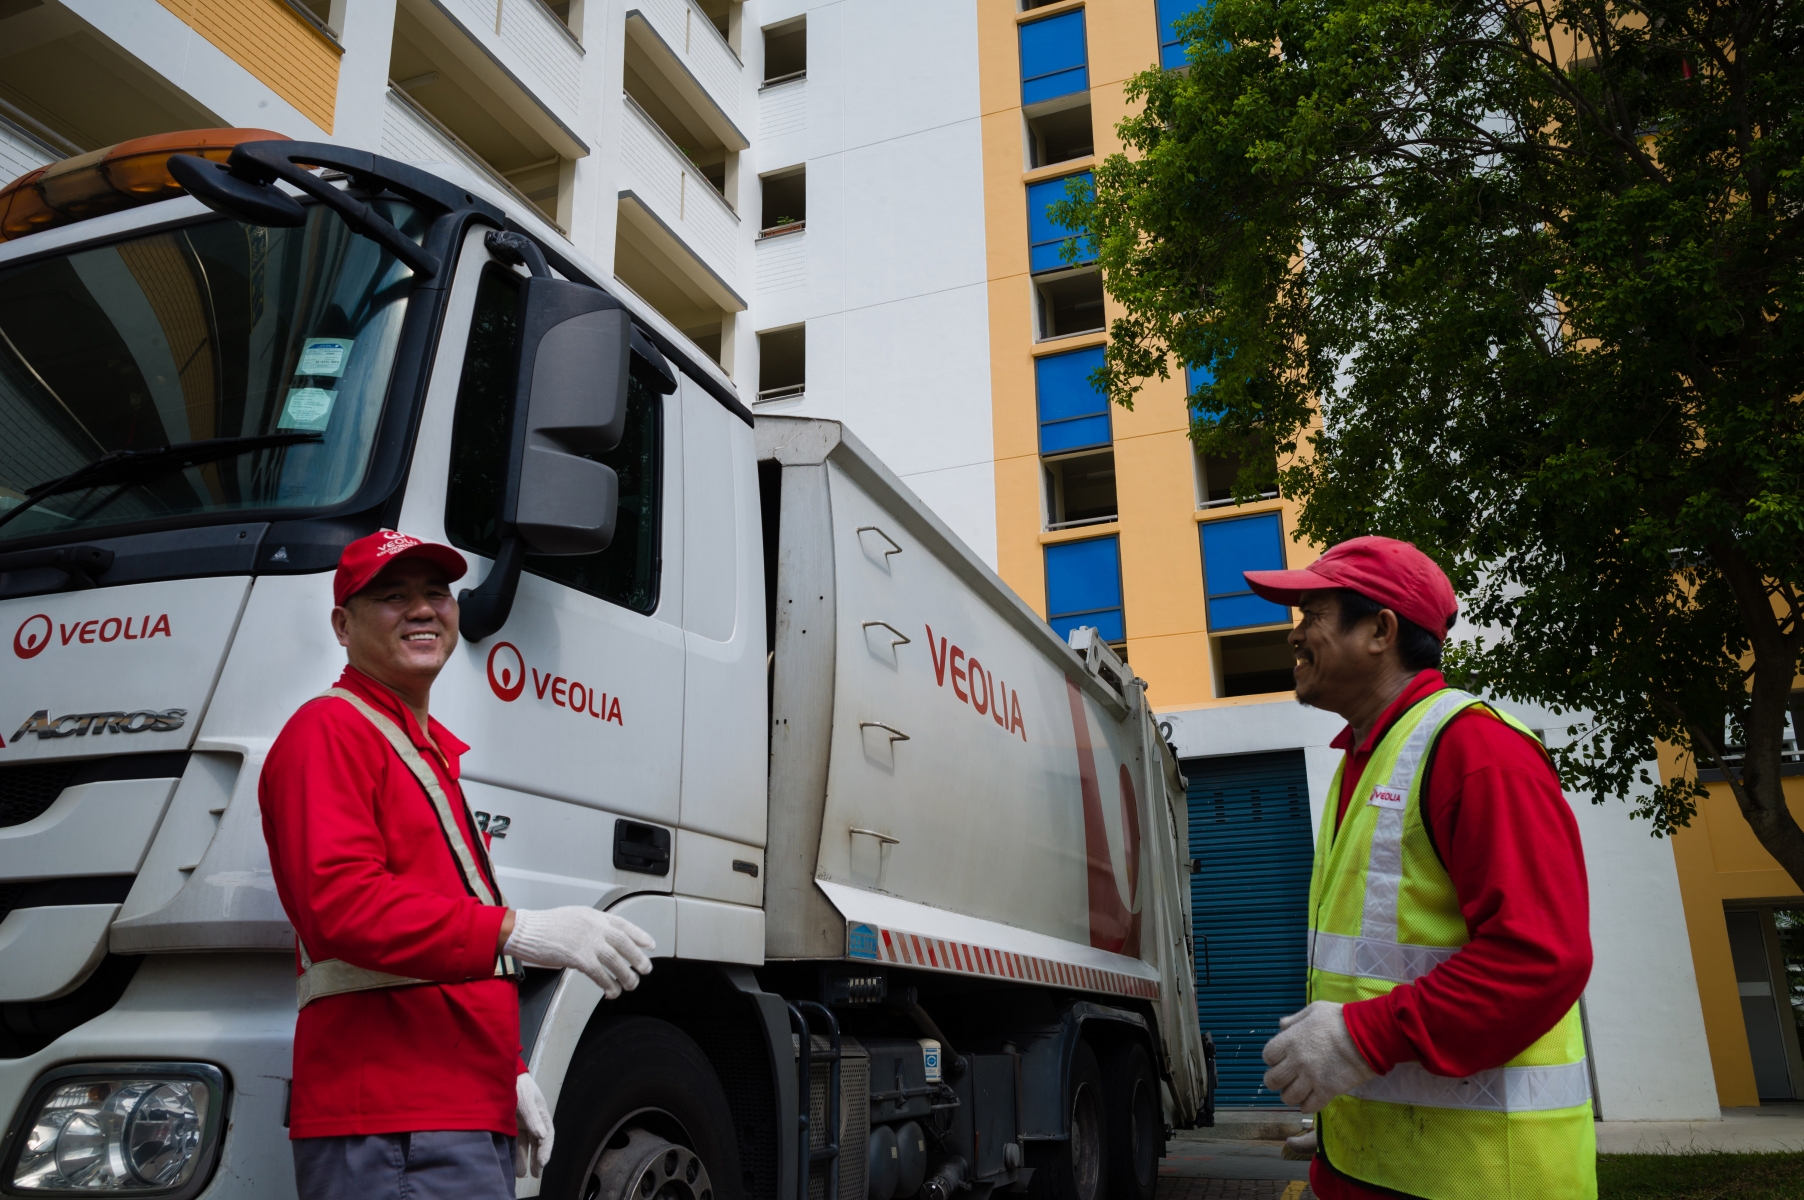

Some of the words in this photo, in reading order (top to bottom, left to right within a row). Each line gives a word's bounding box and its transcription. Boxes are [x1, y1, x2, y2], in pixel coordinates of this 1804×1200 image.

[59, 613, 172, 646] VEOLIA
[531, 667, 623, 726] VEOLIA
[925, 624, 1027, 742] VEOLIA
[1375, 790, 1401, 802] VEOLIA
